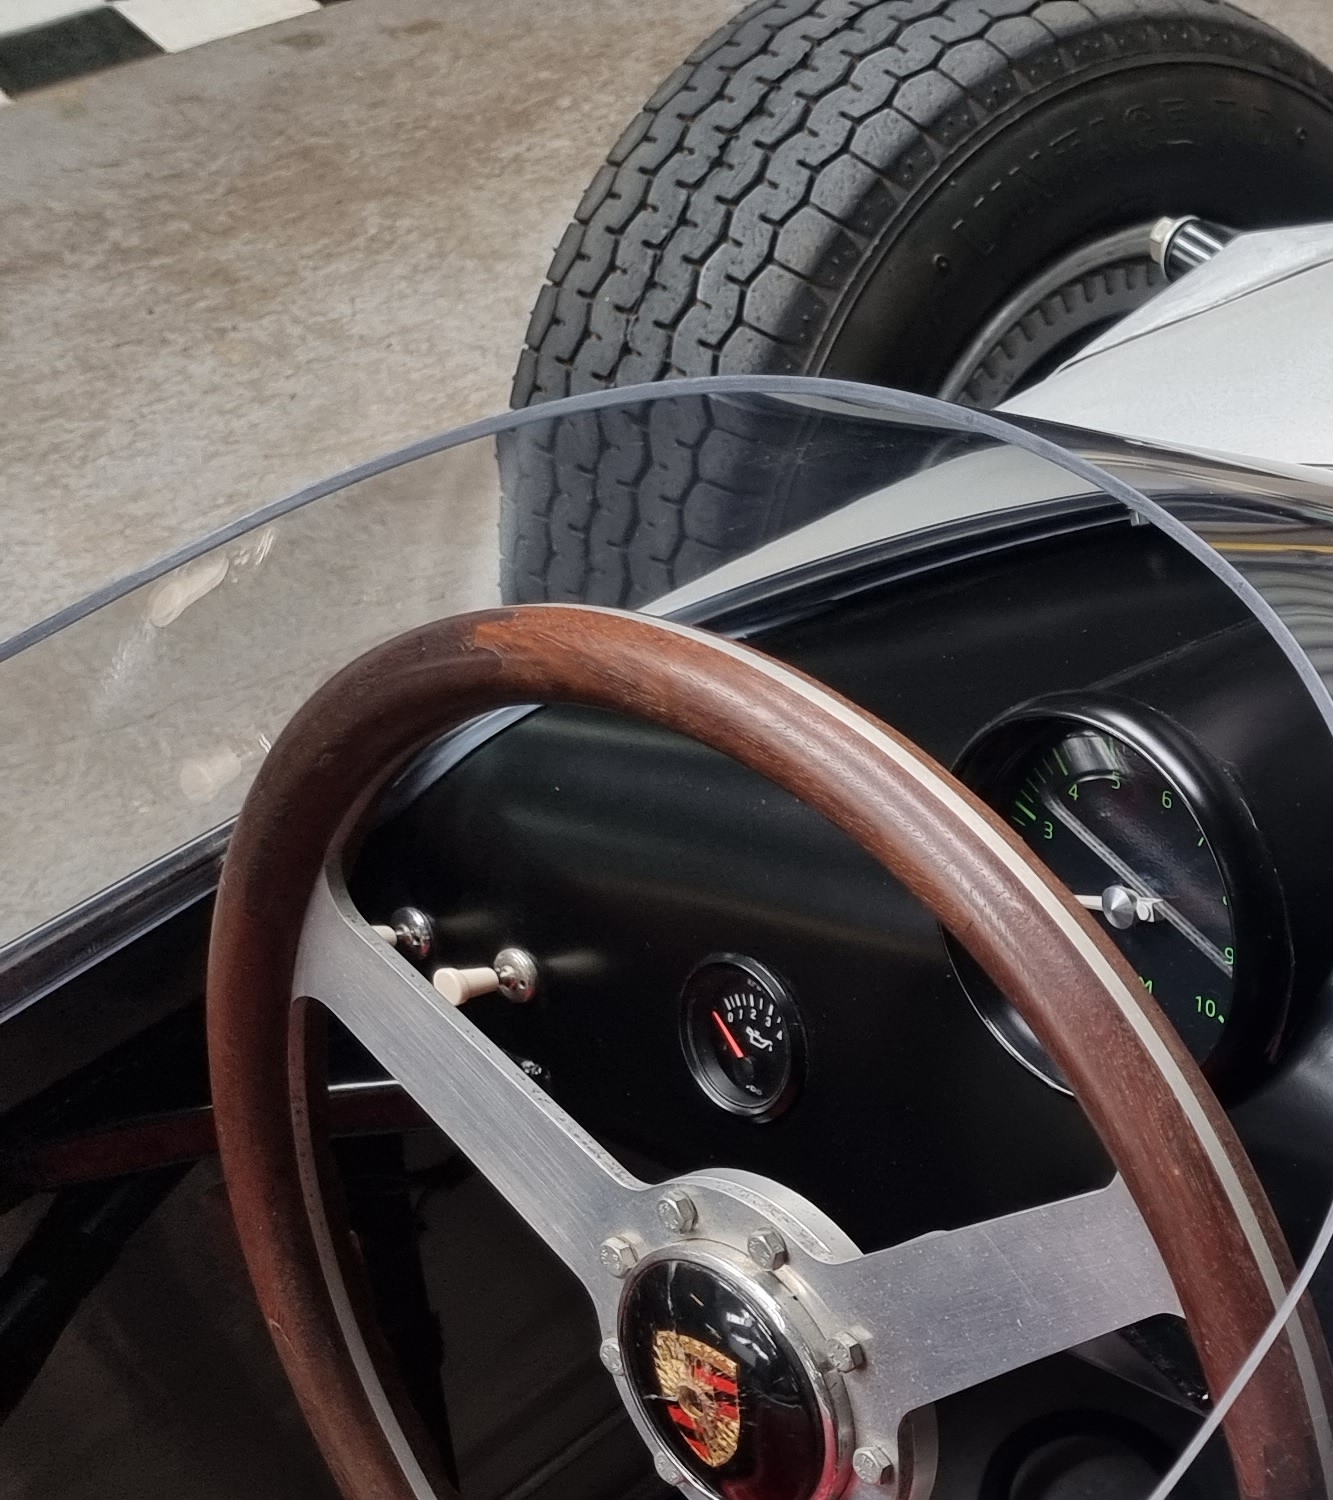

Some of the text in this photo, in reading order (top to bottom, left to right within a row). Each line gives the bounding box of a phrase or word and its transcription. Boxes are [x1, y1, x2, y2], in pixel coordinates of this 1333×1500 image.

[1112, 771, 1121, 790] 5
[1068, 783, 1079, 801] 4
[1161, 790, 1172, 809] 6
[1043, 820, 1054, 840] 3
[1224, 946, 1234, 965] 9
[1195, 995, 1216, 1018] 10
[727, 1008, 783, 1041] 0 1 2 3 4
